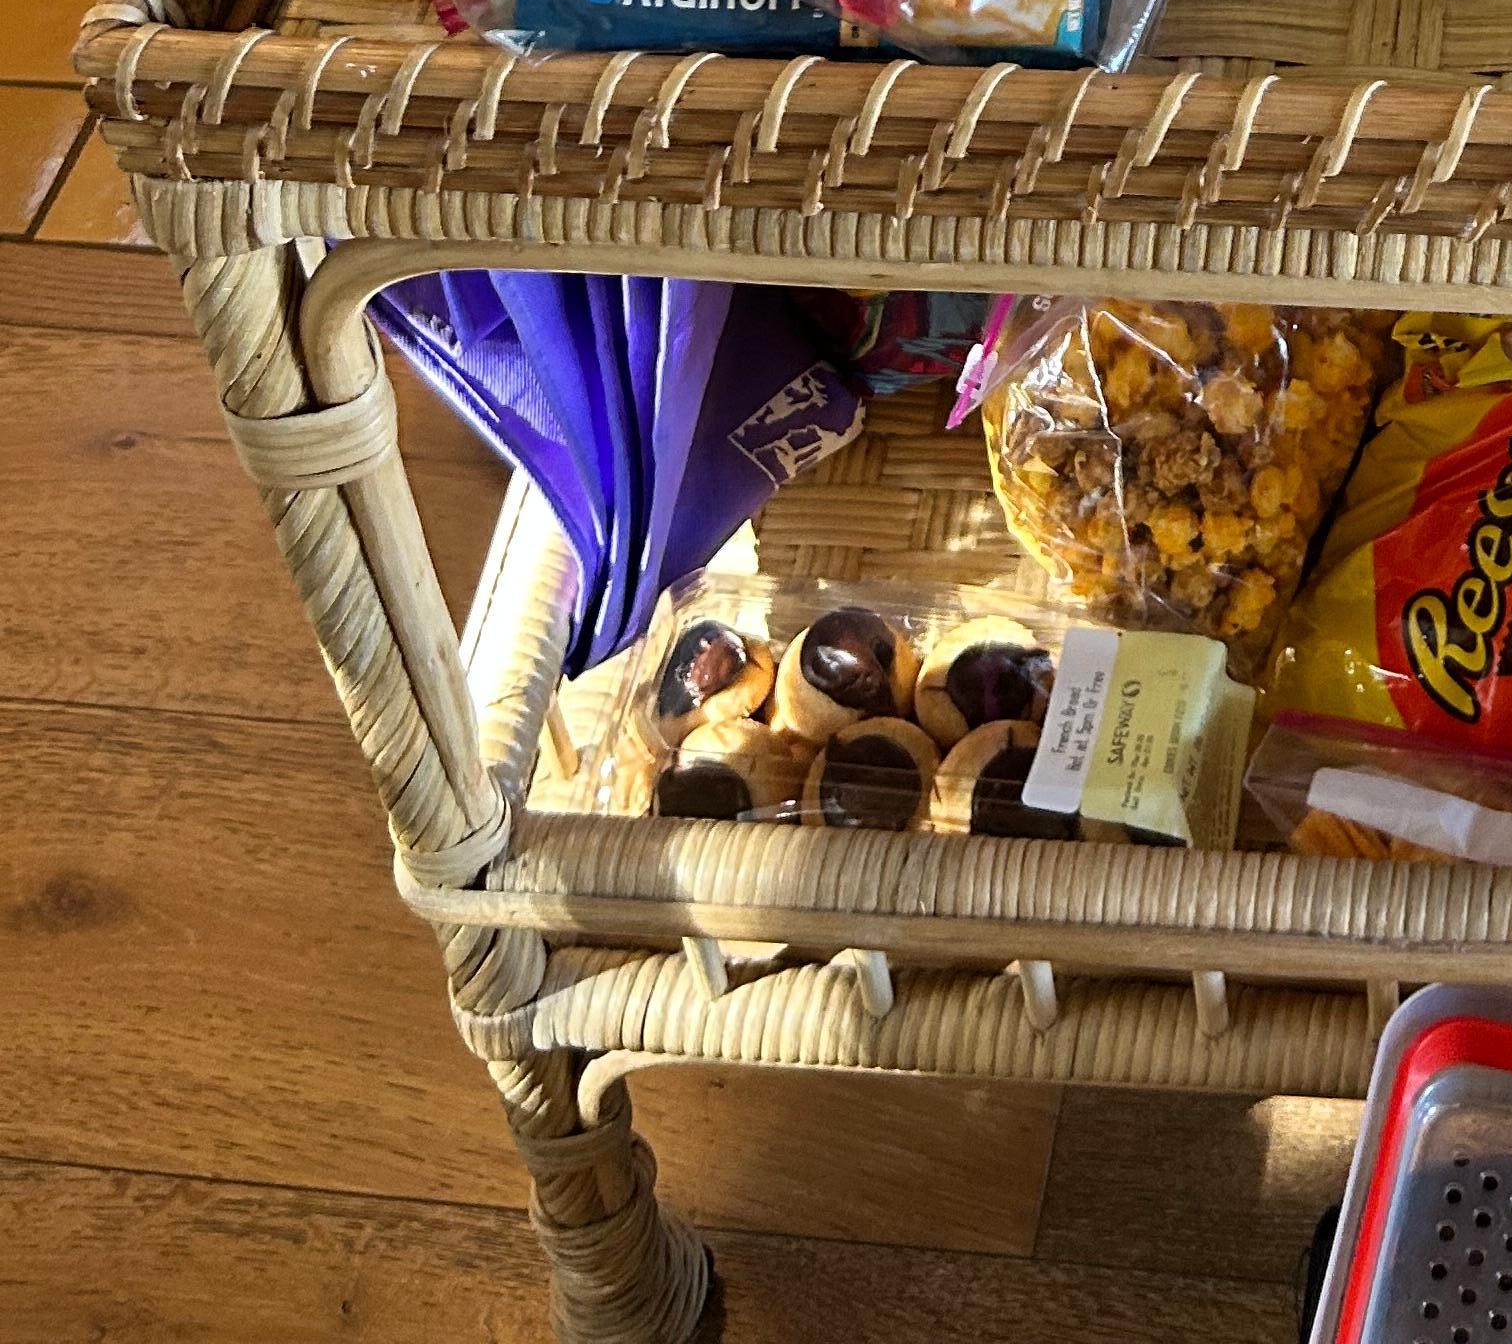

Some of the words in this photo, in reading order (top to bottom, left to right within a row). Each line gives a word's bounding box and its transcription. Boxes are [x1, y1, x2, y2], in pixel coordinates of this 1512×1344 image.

[1084, 670, 1106, 694] Free
[1050, 720, 1074, 755] French
[1107, 701, 1136, 767] SAFEWAY
